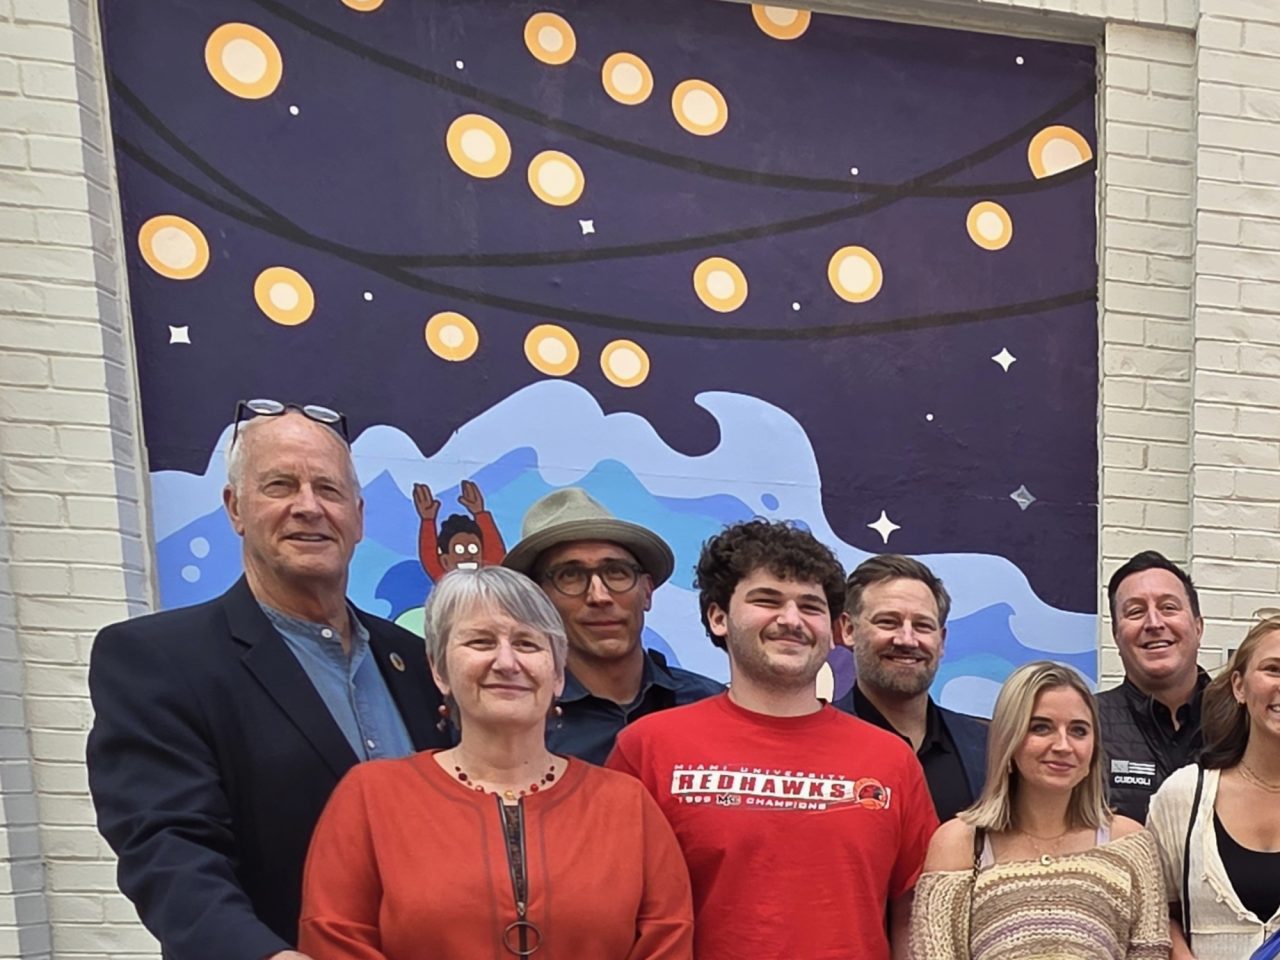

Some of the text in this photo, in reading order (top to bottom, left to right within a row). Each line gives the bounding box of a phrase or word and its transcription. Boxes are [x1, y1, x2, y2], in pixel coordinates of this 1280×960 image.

[674, 764, 845, 780] MIAMI UNIVERSITY
[678, 773, 846, 799] REDHAWKS
[745, 797, 827, 810] CHAMPIONS
